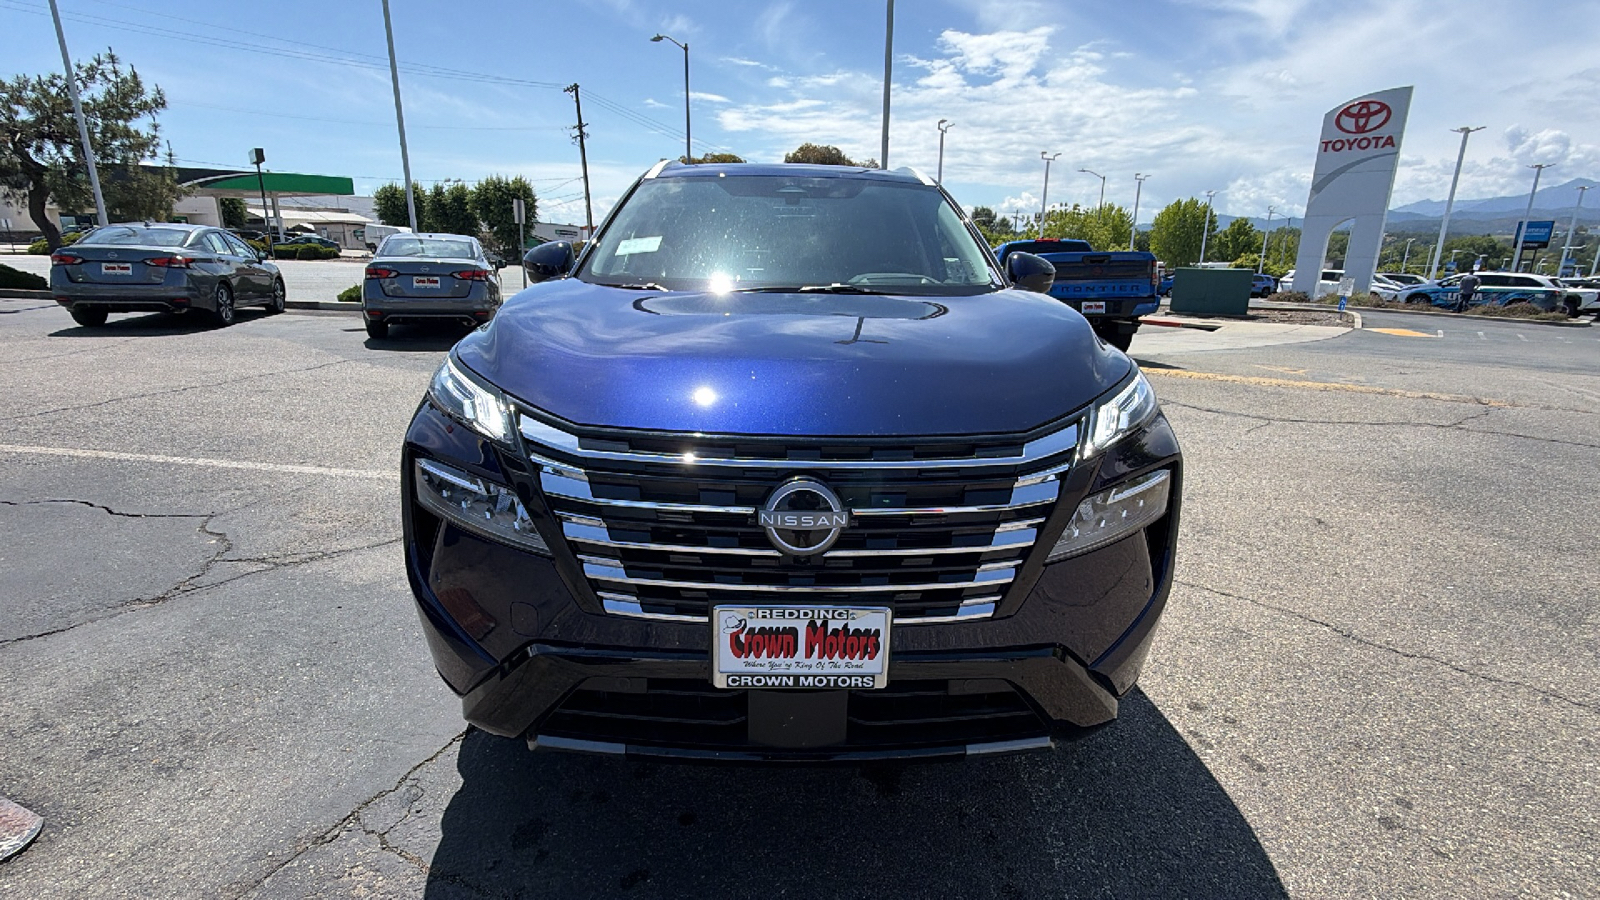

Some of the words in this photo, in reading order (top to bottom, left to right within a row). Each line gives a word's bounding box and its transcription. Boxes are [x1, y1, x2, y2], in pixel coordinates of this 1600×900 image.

[1321, 135, 1395, 152] TOYOTA
[761, 512, 846, 526] NISSAN
[757, 609, 848, 619] REDDING
[729, 624, 798, 659] Crown
[805, 622, 880, 660] Motors
[795, 661, 813, 670] King
[815, 661, 825, 670] Of
[828, 661, 842, 669] The
[844, 661, 864, 669] Road
[727, 676, 794, 687] CROWN
[800, 676, 874, 687] MOTORS
